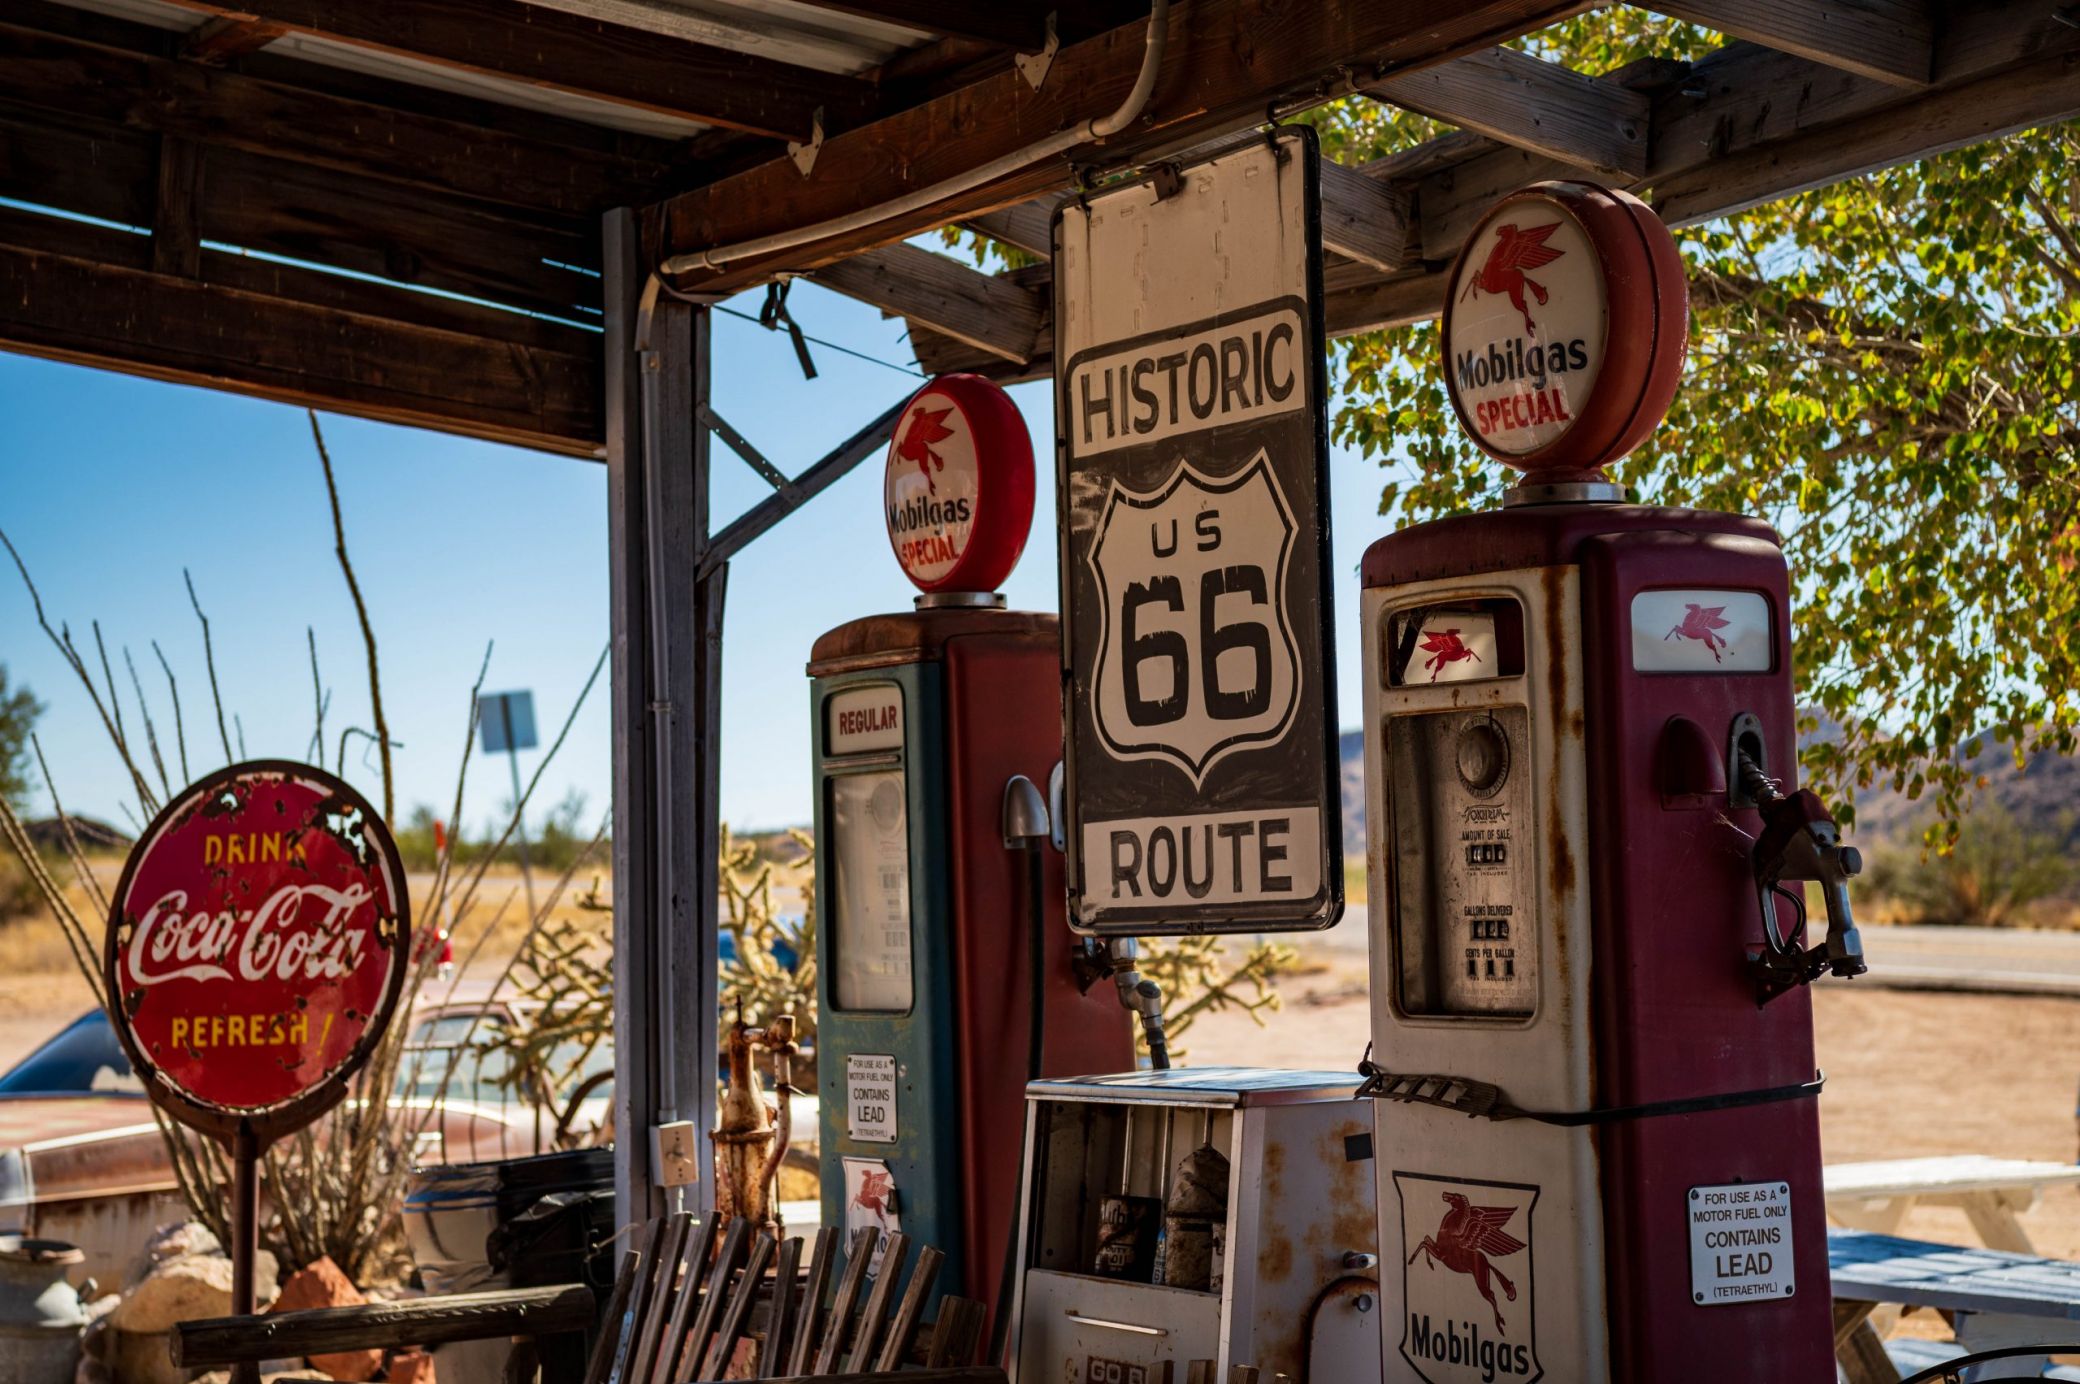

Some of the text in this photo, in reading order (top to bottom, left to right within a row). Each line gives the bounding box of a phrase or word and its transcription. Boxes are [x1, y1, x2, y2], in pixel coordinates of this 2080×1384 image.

[1457, 337, 1589, 392] Mobilgas
[1080, 322, 1295, 445] HISTORIC
[1476, 388, 1569, 436] SPECIAL
[889, 496, 970, 536] Mobilgas
[901, 535, 960, 570] SPECIAL
[1121, 564, 1272, 727] 66
[839, 705, 898, 736] REGULAR
[1461, 828, 1511, 841] AMOUNT OF SALE
[1110, 817, 1293, 899] ROUTE
[1464, 905, 1513, 916] GALLONS DELIVERED
[128, 883, 379, 985] Coca-Cola
[1465, 948, 1480, 958] CENTS
[1482, 948, 1493, 958] PER
[853, 1059, 888, 1069] FOR USE AS A
[849, 1072, 894, 1082] MOTOR FUEL ONLY
[853, 1087, 890, 1101] CONTAINS
[858, 1105, 885, 1123] LEAD
[1705, 1189, 1777, 1205] FOR USE AS A
[1693, 1205, 1788, 1223] MOTOR FUEL ONLY
[1705, 1226, 1781, 1249] CONTAINS
[1716, 1251, 1773, 1278] LEAD
[1713, 1281, 1778, 1298] (TETRAETHYL)
[1411, 1312, 1530, 1384] Mobilgas
